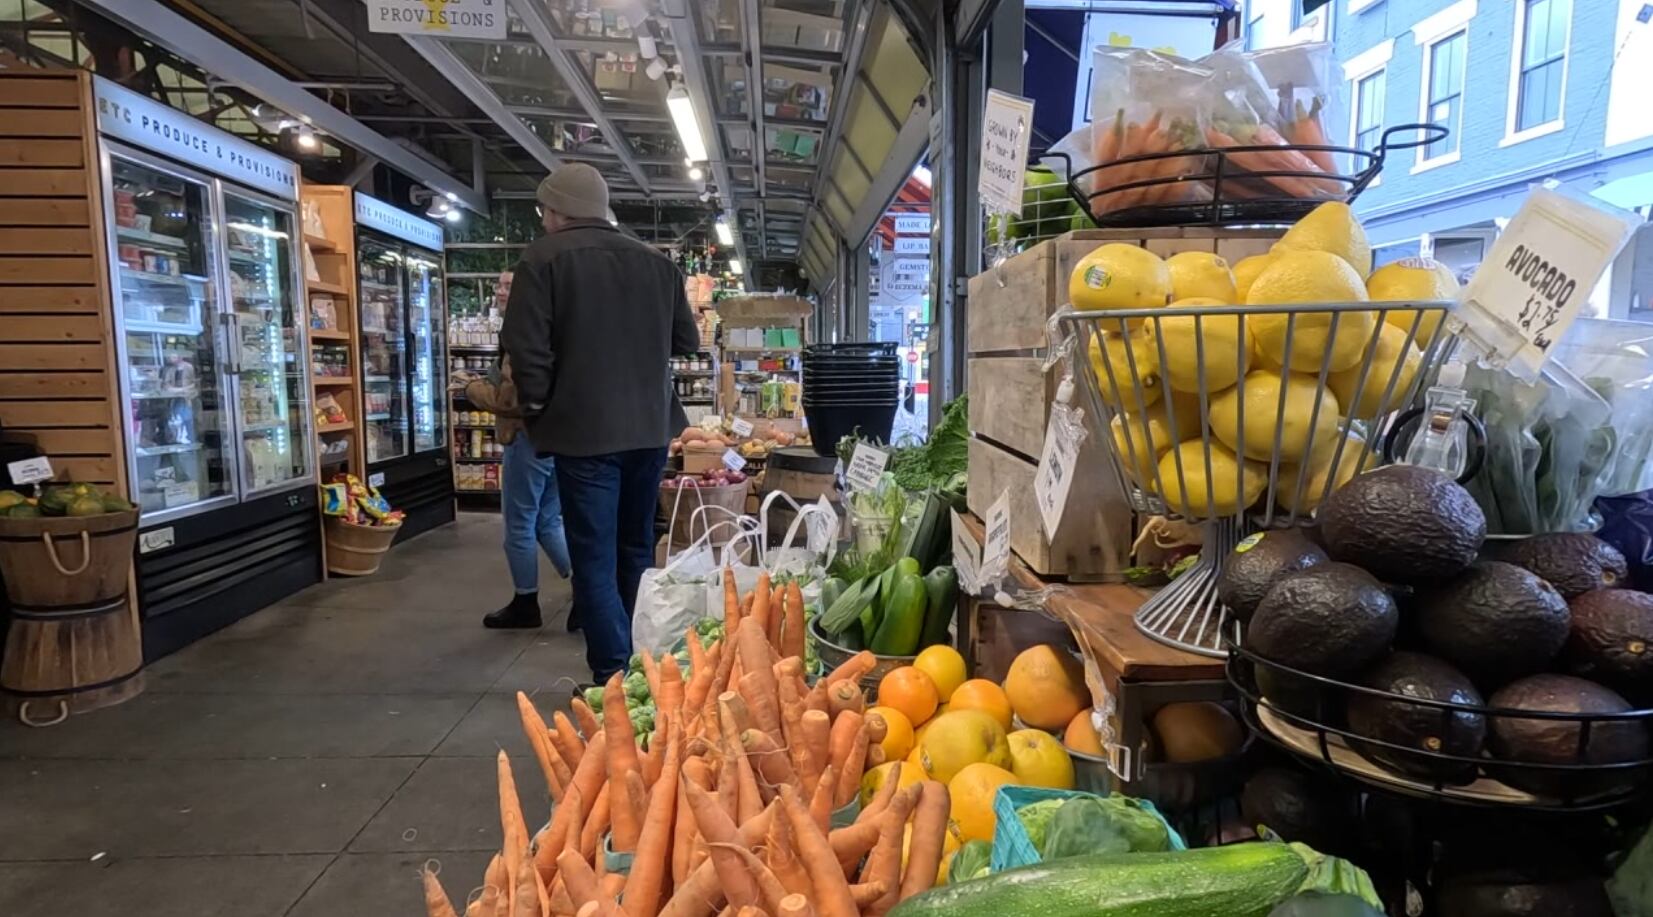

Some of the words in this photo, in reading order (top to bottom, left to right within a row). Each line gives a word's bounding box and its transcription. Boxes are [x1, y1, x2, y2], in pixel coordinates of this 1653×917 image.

[379, 7, 495, 28] PROVISIONS
[987, 119, 1008, 139] GROWN
[98, 97, 132, 123] ETC
[142, 115, 209, 154] PRODUCE
[216, 146, 223, 159] &
[231, 151, 295, 187] PROVISIONS
[898, 220, 920, 228] MADE
[902, 241, 915, 249] LIP
[1505, 244, 1576, 309] AVOCADO
